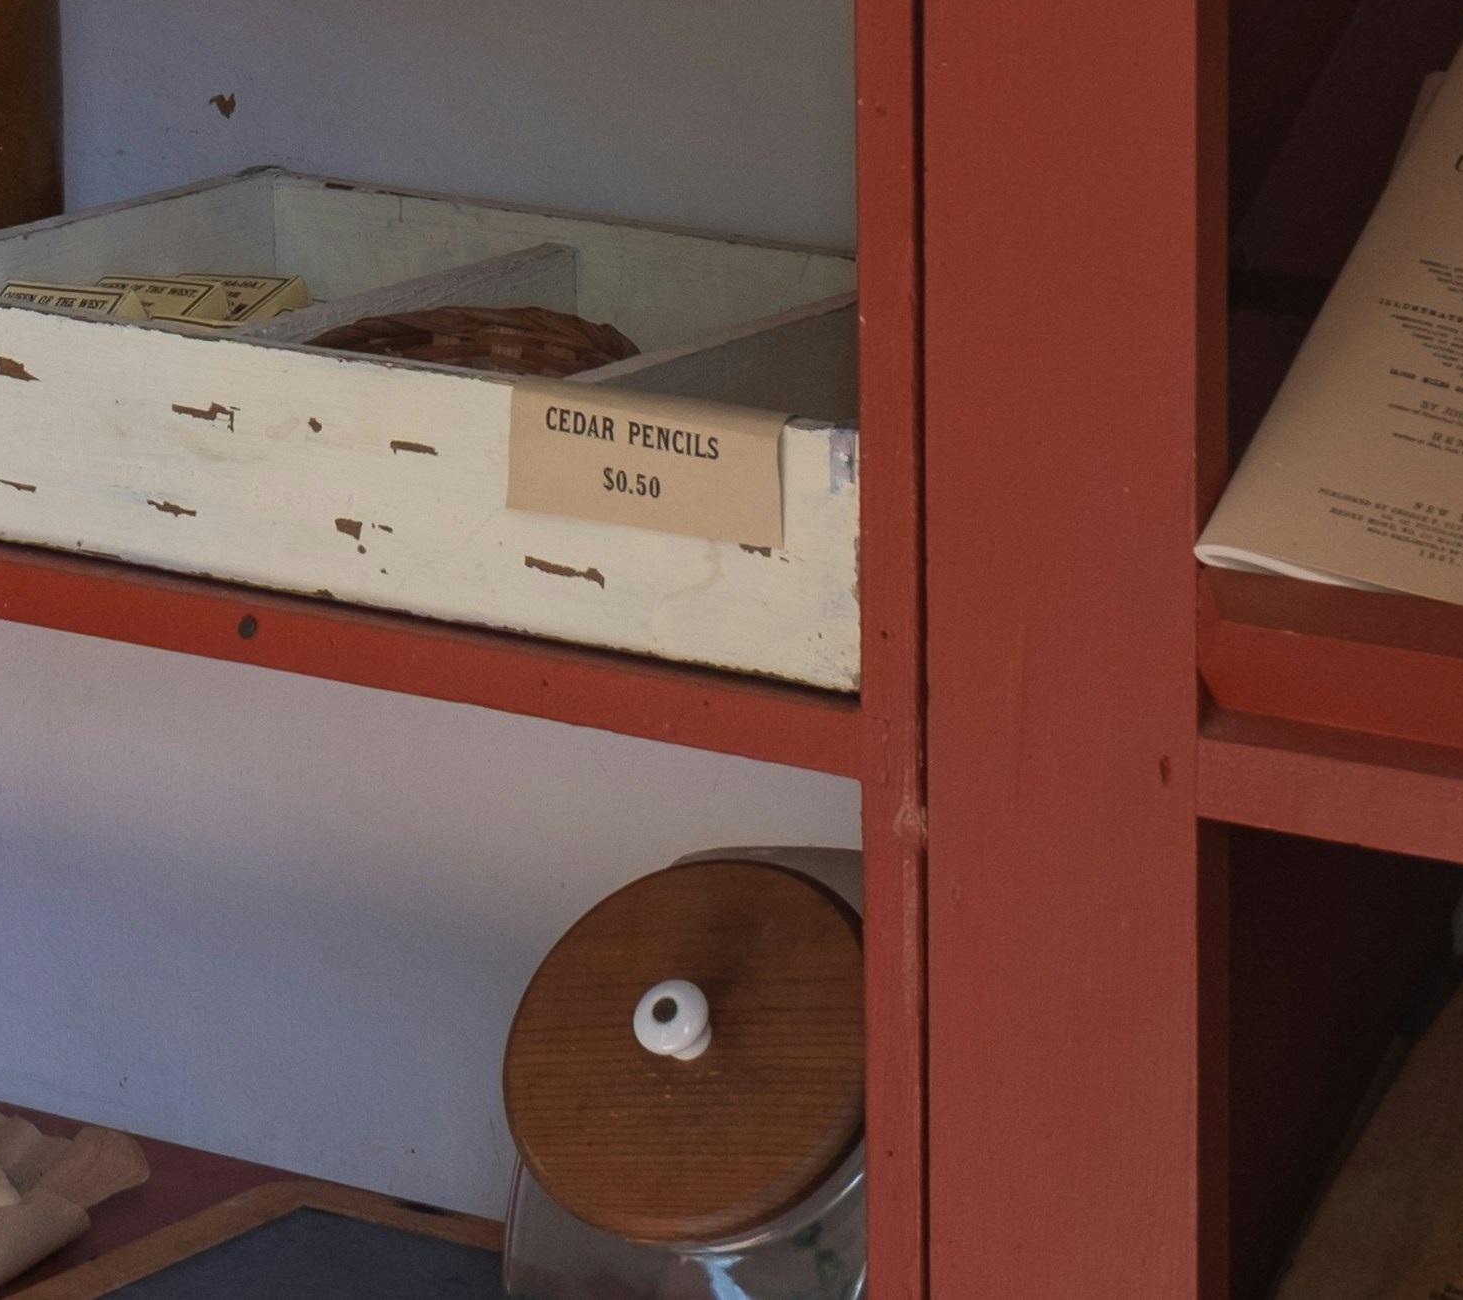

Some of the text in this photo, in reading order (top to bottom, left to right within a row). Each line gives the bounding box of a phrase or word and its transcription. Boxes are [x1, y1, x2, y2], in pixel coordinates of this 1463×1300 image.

[144, 283, 198, 299] THE WEST.
[37, 294, 54, 306] OF
[55, 296, 77, 308] THE
[78, 297, 108, 310] WEST.
[1420, 399, 1440, 412] BY
[546, 406, 719, 460] CEDAR PENCILS
[603, 467, 661, 499] $0.50
[1317, 486, 1372, 507] PUBLISHED
[1374, 502, 1388, 512] BY
[1413, 501, 1449, 517] NEW
